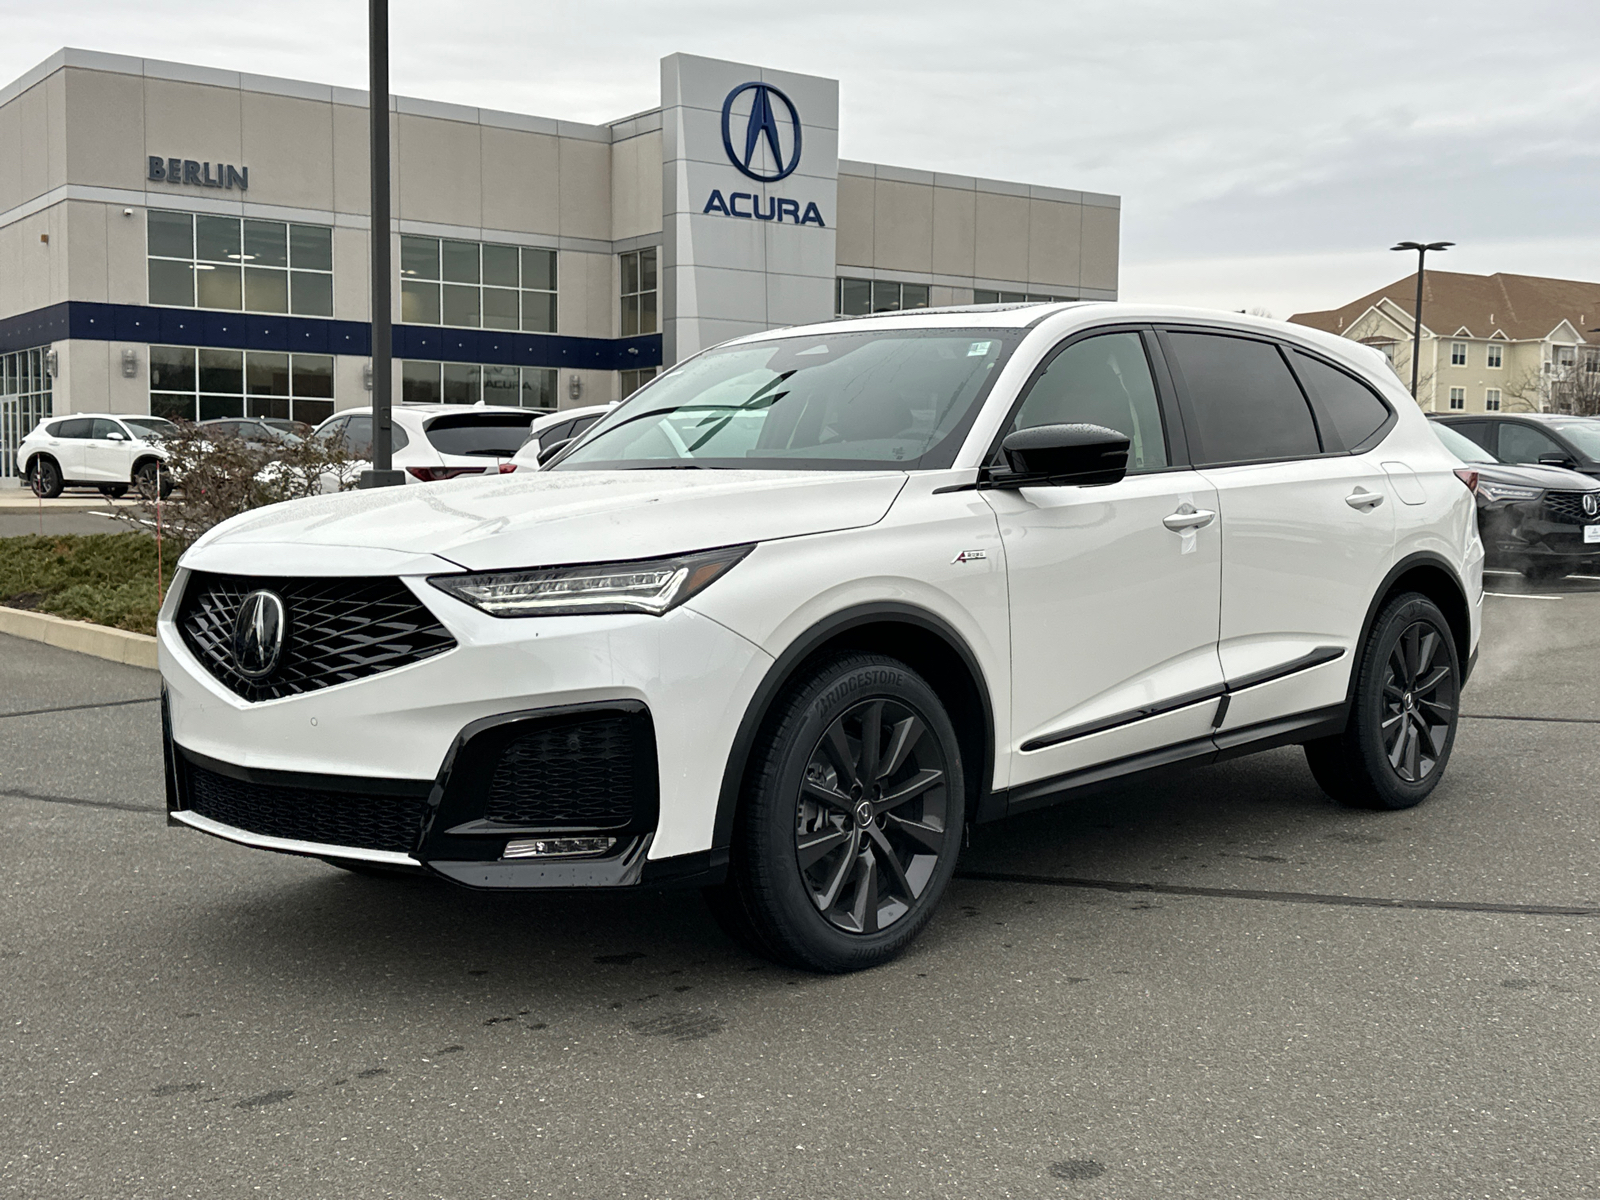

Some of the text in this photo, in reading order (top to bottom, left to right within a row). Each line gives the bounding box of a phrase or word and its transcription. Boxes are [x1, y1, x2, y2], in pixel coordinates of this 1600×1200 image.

[148, 156, 248, 190] BERLIN
[703, 189, 825, 227] ACURA
[814, 670, 903, 717] BRIDGESTONE
